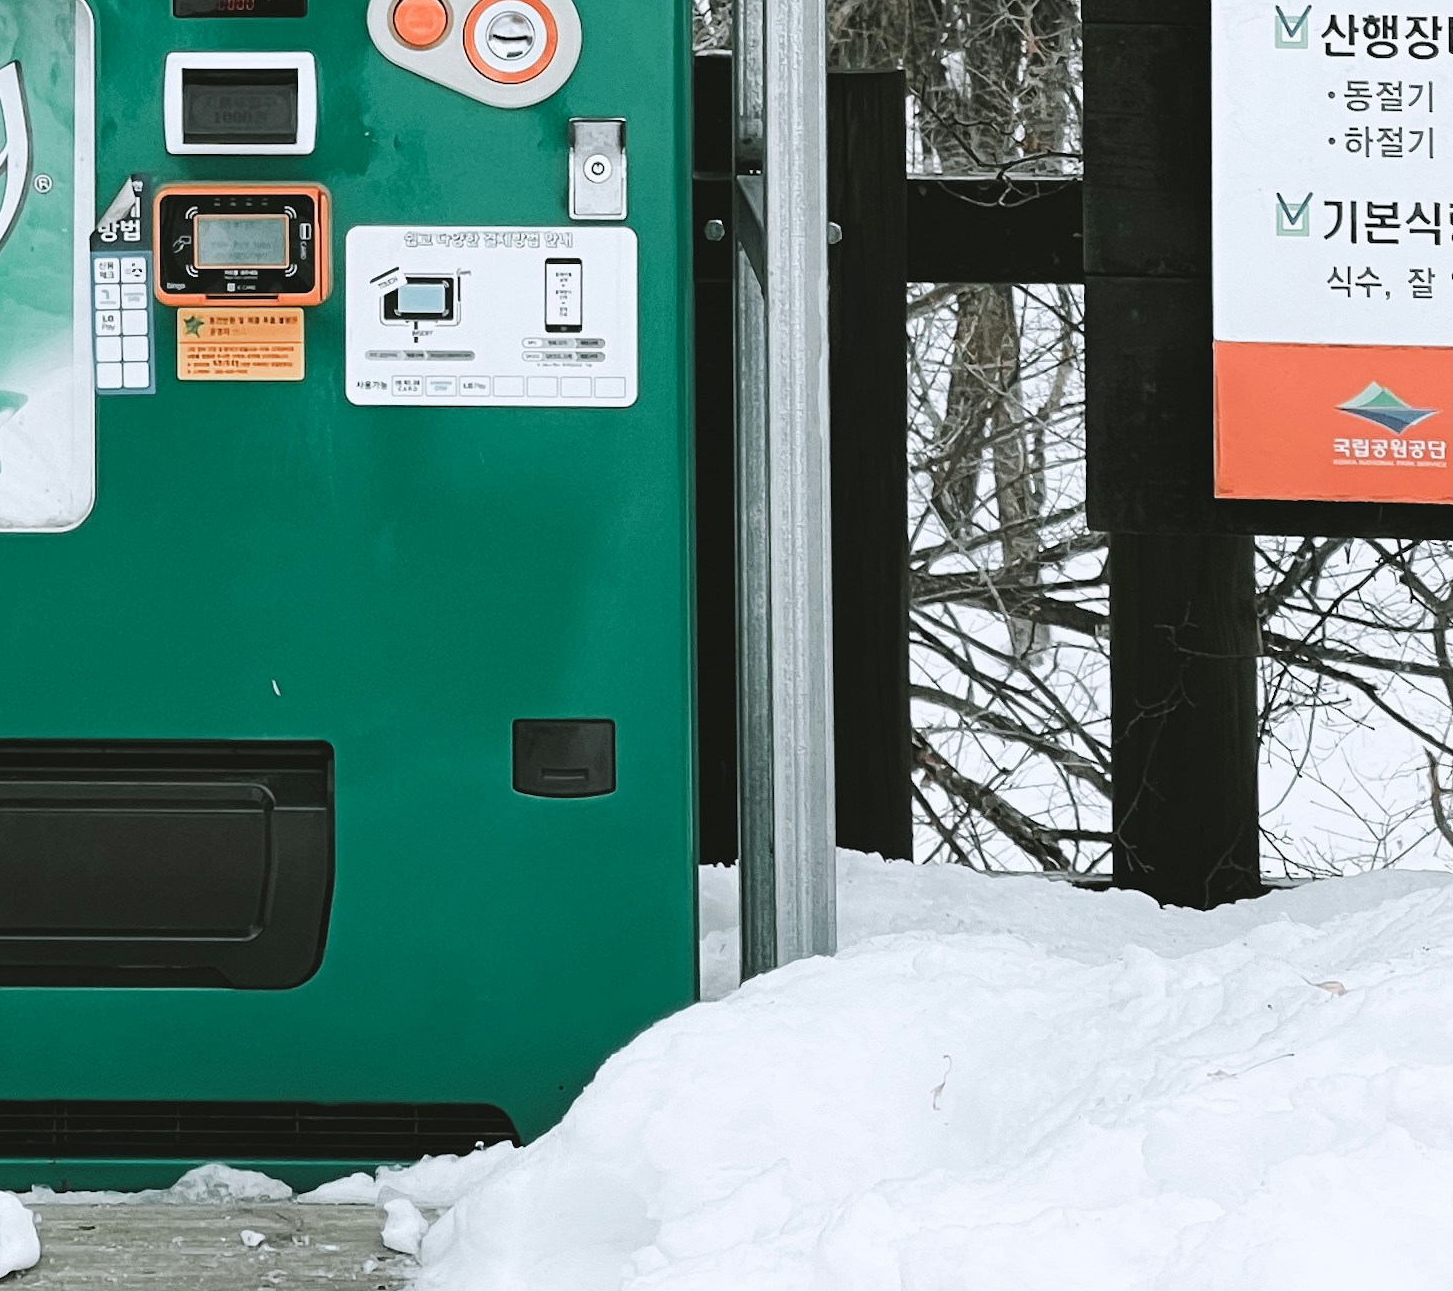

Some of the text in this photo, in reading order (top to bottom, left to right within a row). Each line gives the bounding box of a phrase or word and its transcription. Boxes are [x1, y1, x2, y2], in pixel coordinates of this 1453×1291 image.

[1320, 13, 1453, 60] 산행장
[1343, 80, 1435, 113] 동절기
[1344, 126, 1436, 159] 하절기
[1323, 200, 1453, 246] 기본식
[1326, 265, 1437, 300] 식수, 잘
[1332, 437, 1447, 460] 국립공원공단
